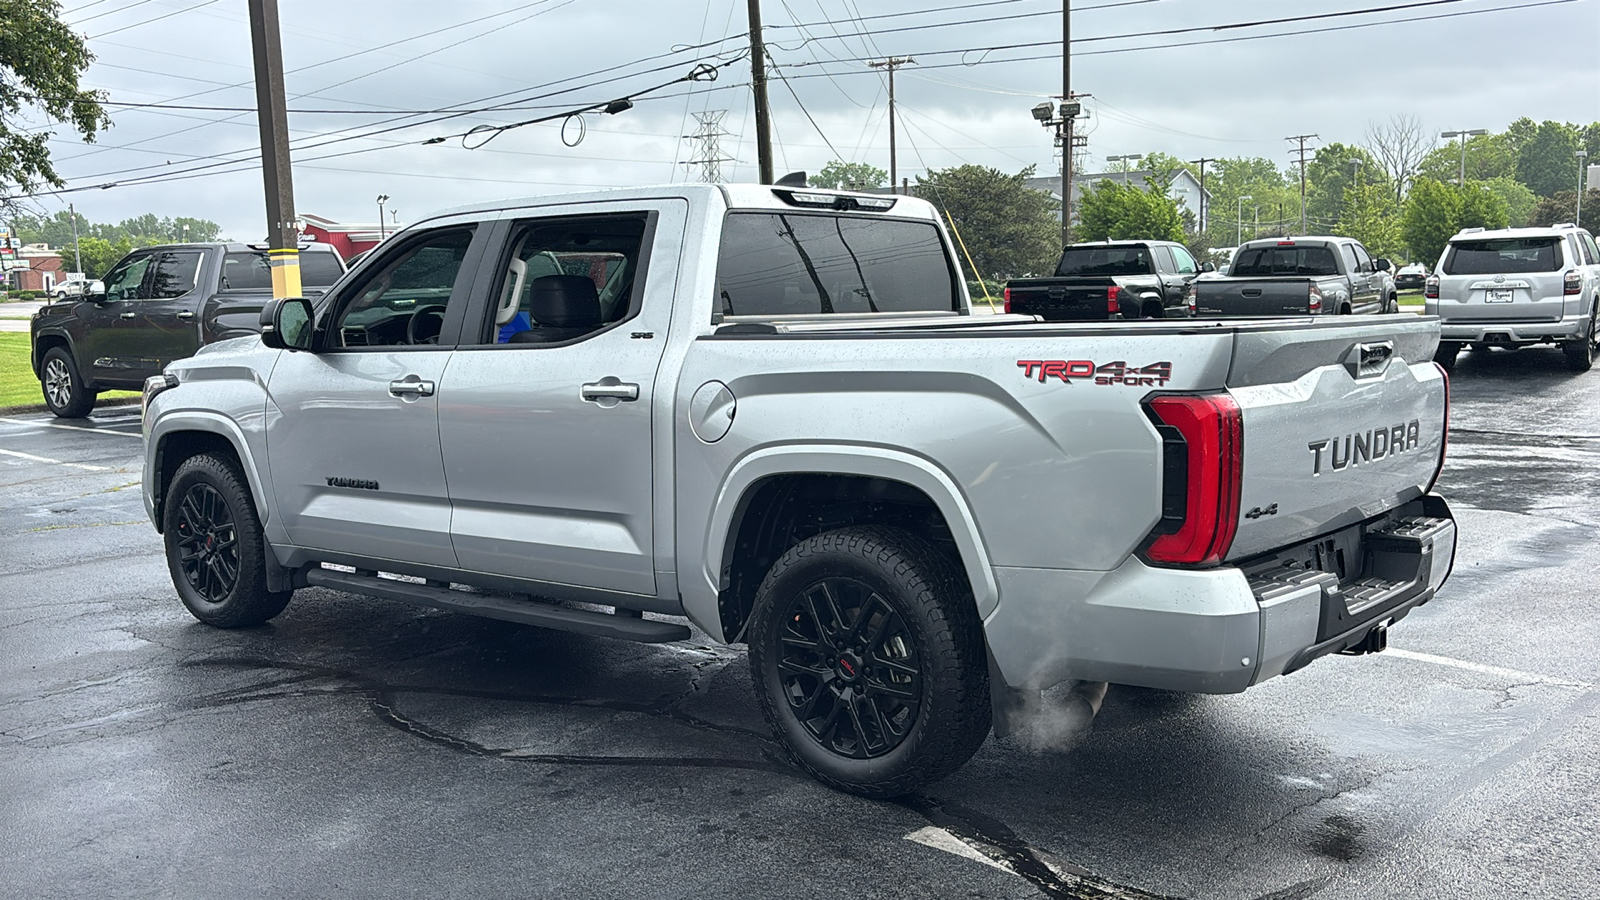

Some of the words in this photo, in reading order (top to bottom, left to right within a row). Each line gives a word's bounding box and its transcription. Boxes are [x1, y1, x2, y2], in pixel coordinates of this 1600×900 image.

[630, 331, 655, 339] SR5
[1017, 360, 1096, 384] TRD
[1095, 360, 1173, 377] 4x4
[1094, 376, 1171, 387] SPORT
[1308, 418, 1420, 477] TUNDRA
[325, 476, 380, 490] TUNDRA
